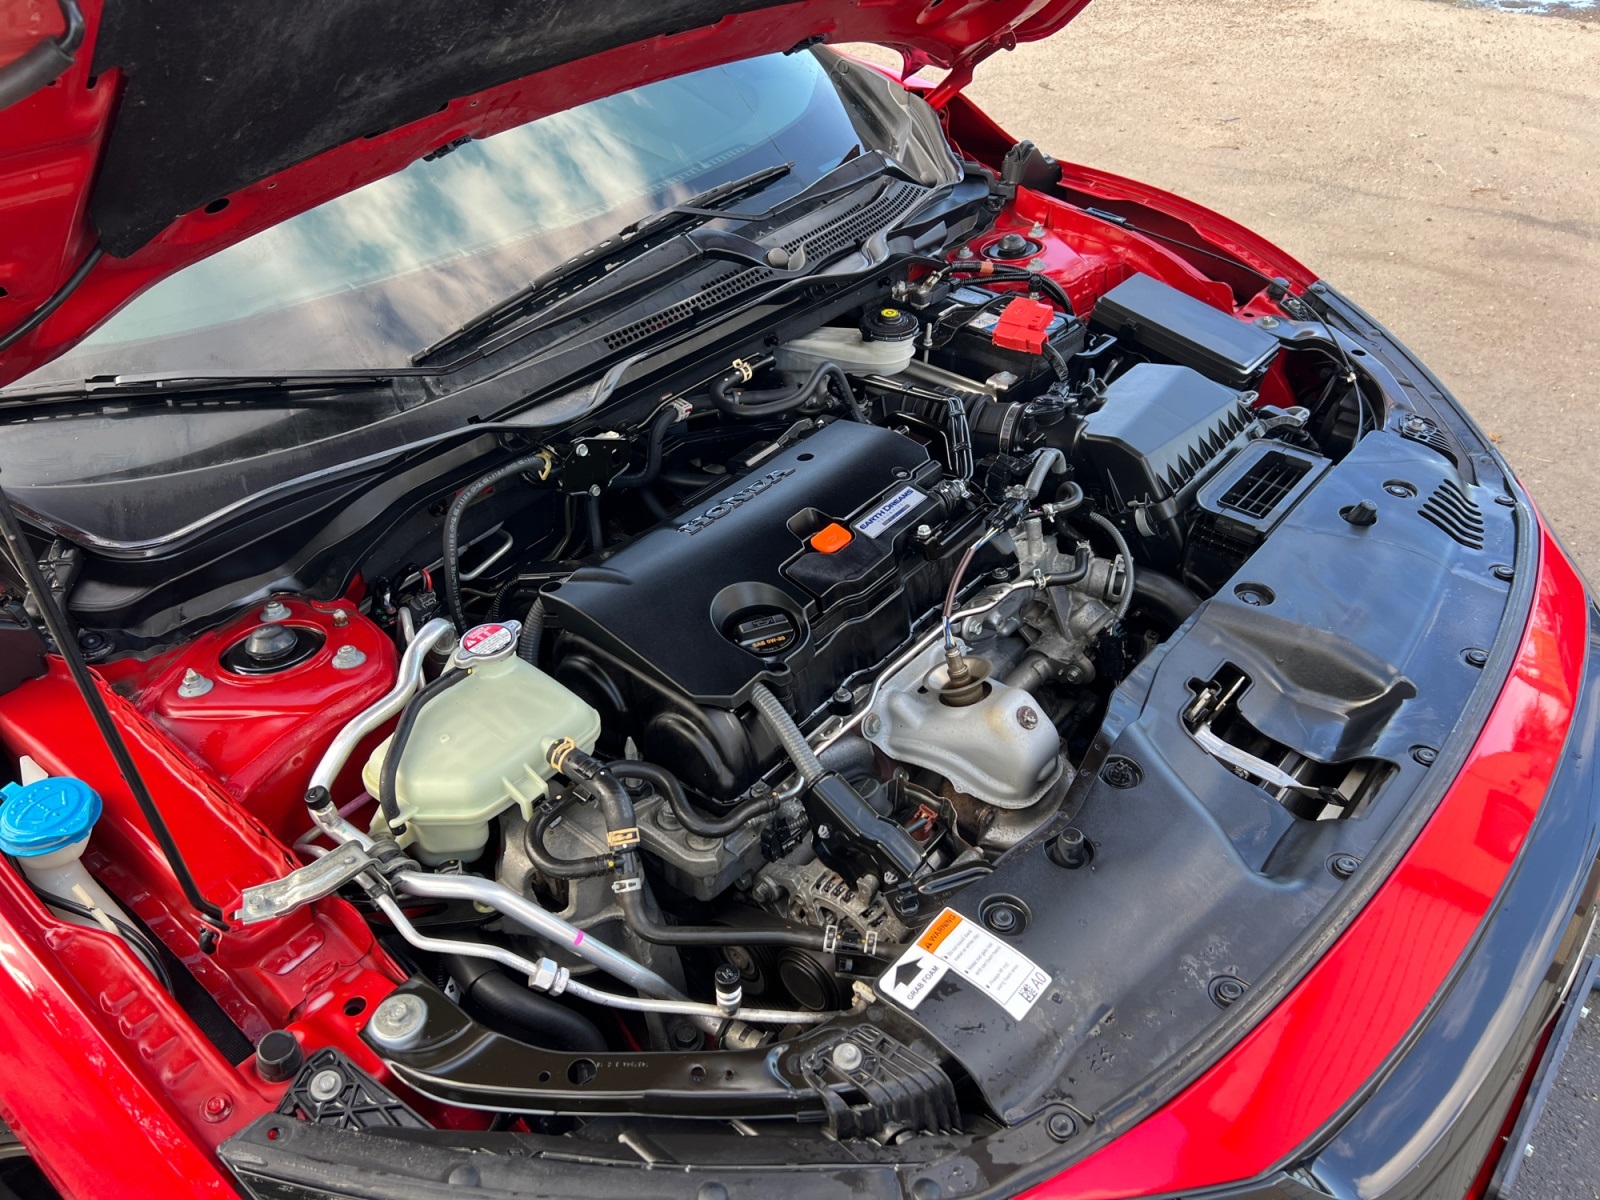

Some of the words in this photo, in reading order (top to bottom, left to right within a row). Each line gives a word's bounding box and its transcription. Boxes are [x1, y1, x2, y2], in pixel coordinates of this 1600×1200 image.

[679, 469, 796, 536] HONDA
[860, 509, 885, 530] EARTH
[882, 489, 914, 512] DREAMS
[929, 914, 957, 943] WARNING
[906, 982, 925, 1001] GRAB
[922, 965, 941, 985] FOAM
